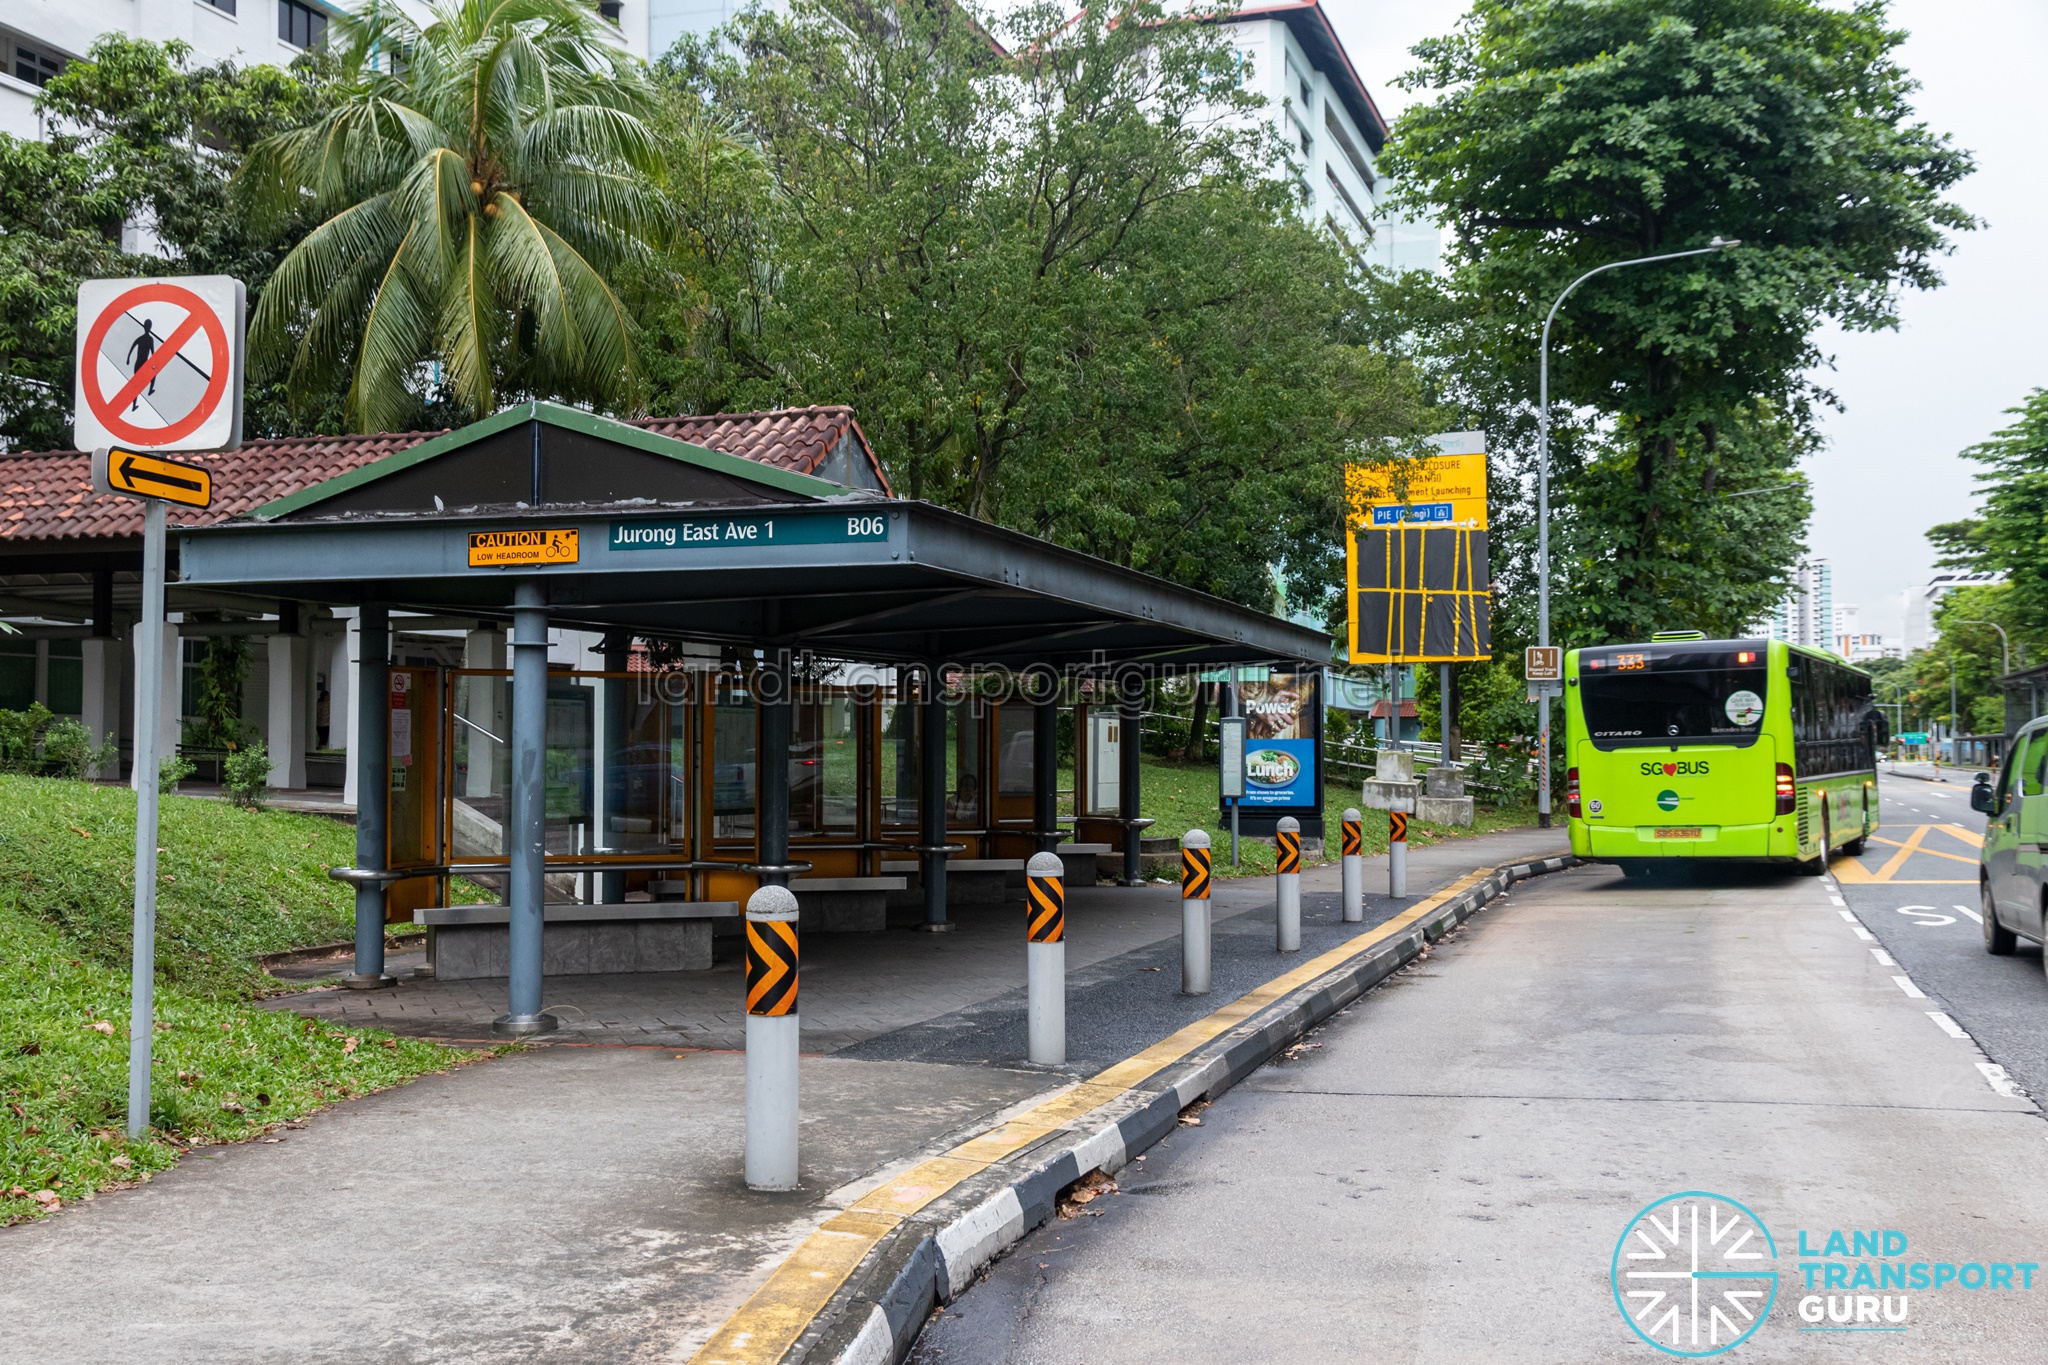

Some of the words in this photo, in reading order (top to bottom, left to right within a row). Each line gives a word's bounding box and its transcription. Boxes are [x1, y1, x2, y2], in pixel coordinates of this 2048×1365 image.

[1431, 486, 1471, 497] Launching
[1377, 510, 1391, 520] PIE
[613, 524, 676, 546] Jurong
[683, 523, 719, 541] East
[725, 522, 758, 540] Ave
[764, 520, 774, 539] 1
[847, 516, 884, 536] B06
[476, 532, 541, 548] CAUTION
[477, 553, 494, 561] LOW
[496, 551, 540, 560] HEADROOM
[1616, 653, 1645, 670] 333
[1247, 760, 1294, 777] Lunch
[1590, 800, 1600, 810] 60
